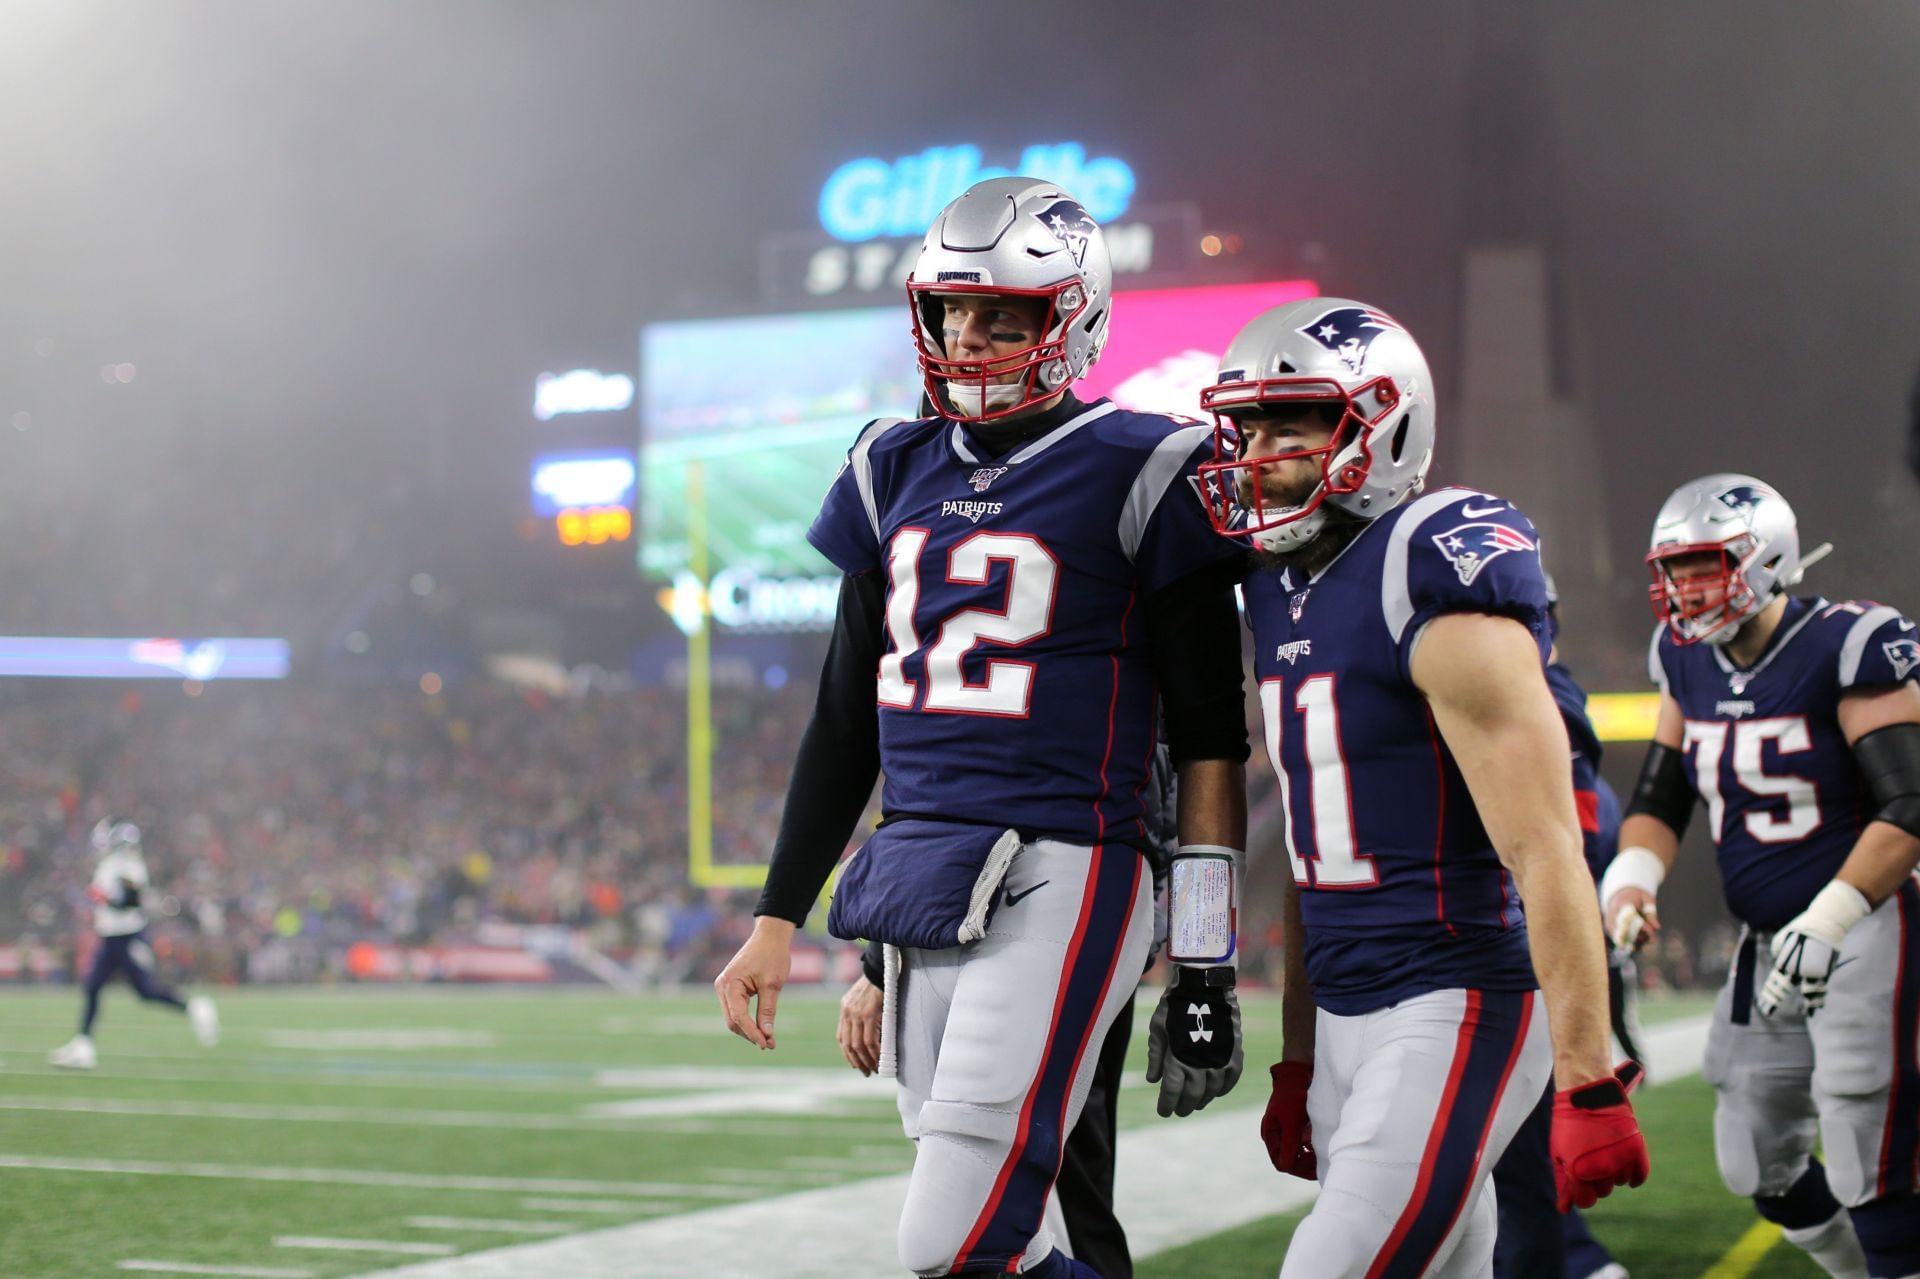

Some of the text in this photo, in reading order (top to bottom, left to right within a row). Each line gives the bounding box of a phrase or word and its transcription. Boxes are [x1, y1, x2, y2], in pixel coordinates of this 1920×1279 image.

[937, 271, 981, 283] PATRIOTS
[941, 501, 1004, 517] PATRIOTS
[877, 526, 1061, 720] 12
[1276, 639, 1312, 662] PATRIOTS
[1258, 672, 1380, 889] 11
[1682, 715, 1824, 845] 75
